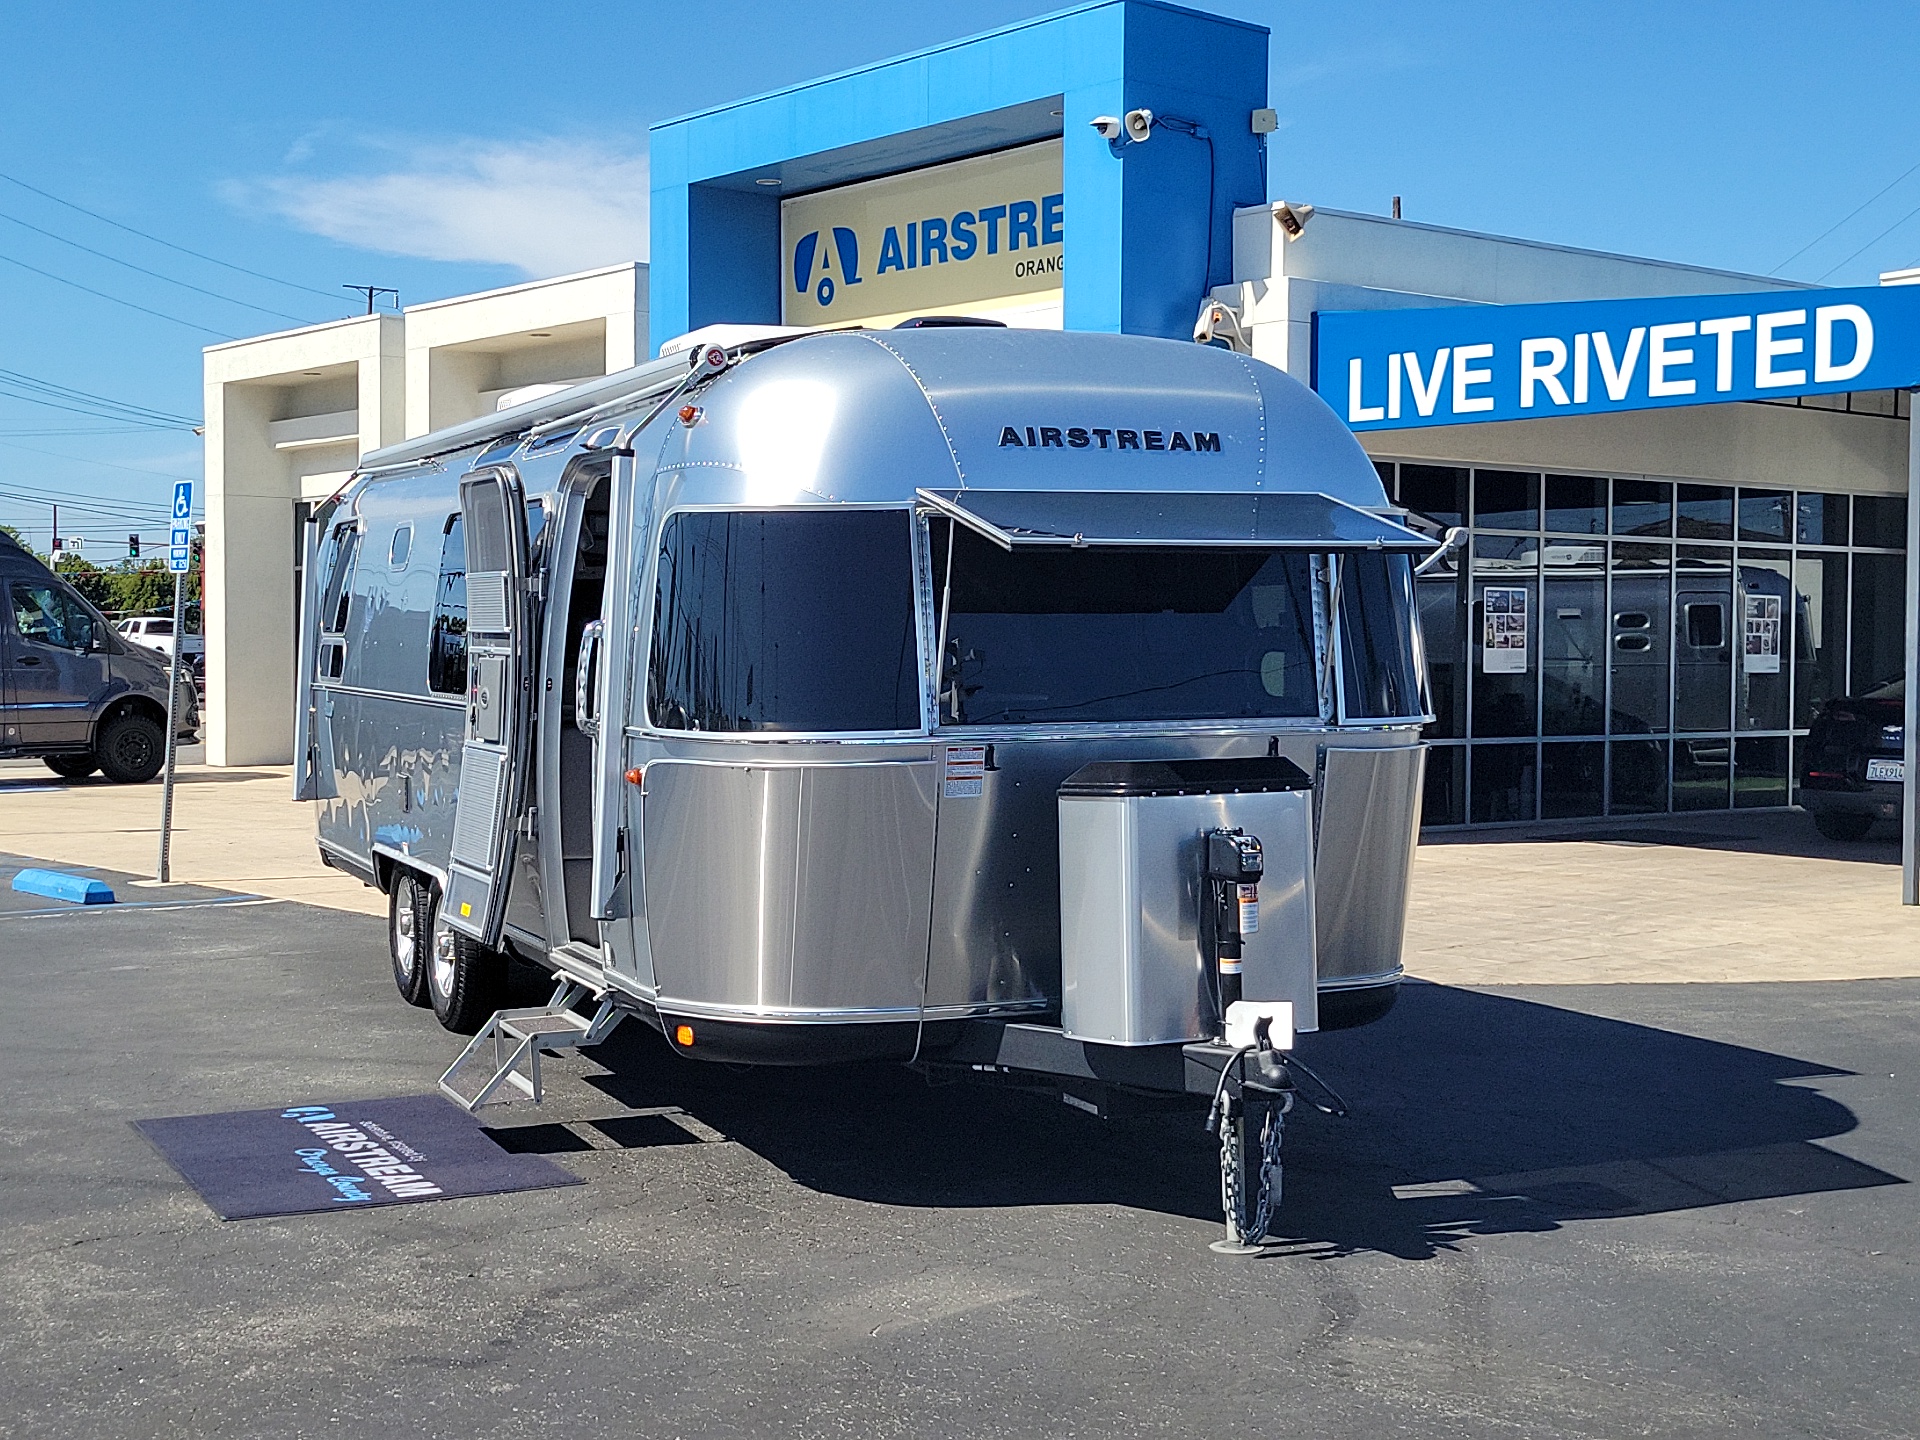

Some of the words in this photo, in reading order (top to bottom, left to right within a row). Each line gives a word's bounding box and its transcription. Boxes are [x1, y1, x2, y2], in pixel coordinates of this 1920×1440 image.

[876, 193, 1064, 275] AIRSTRE
[1348, 343, 1495, 423] LIVE
[1519, 303, 1875, 409] RIVETED
[998, 426, 1222, 453] AIRSTREAM
[304, 1122, 443, 1198] AIRSTREAM
